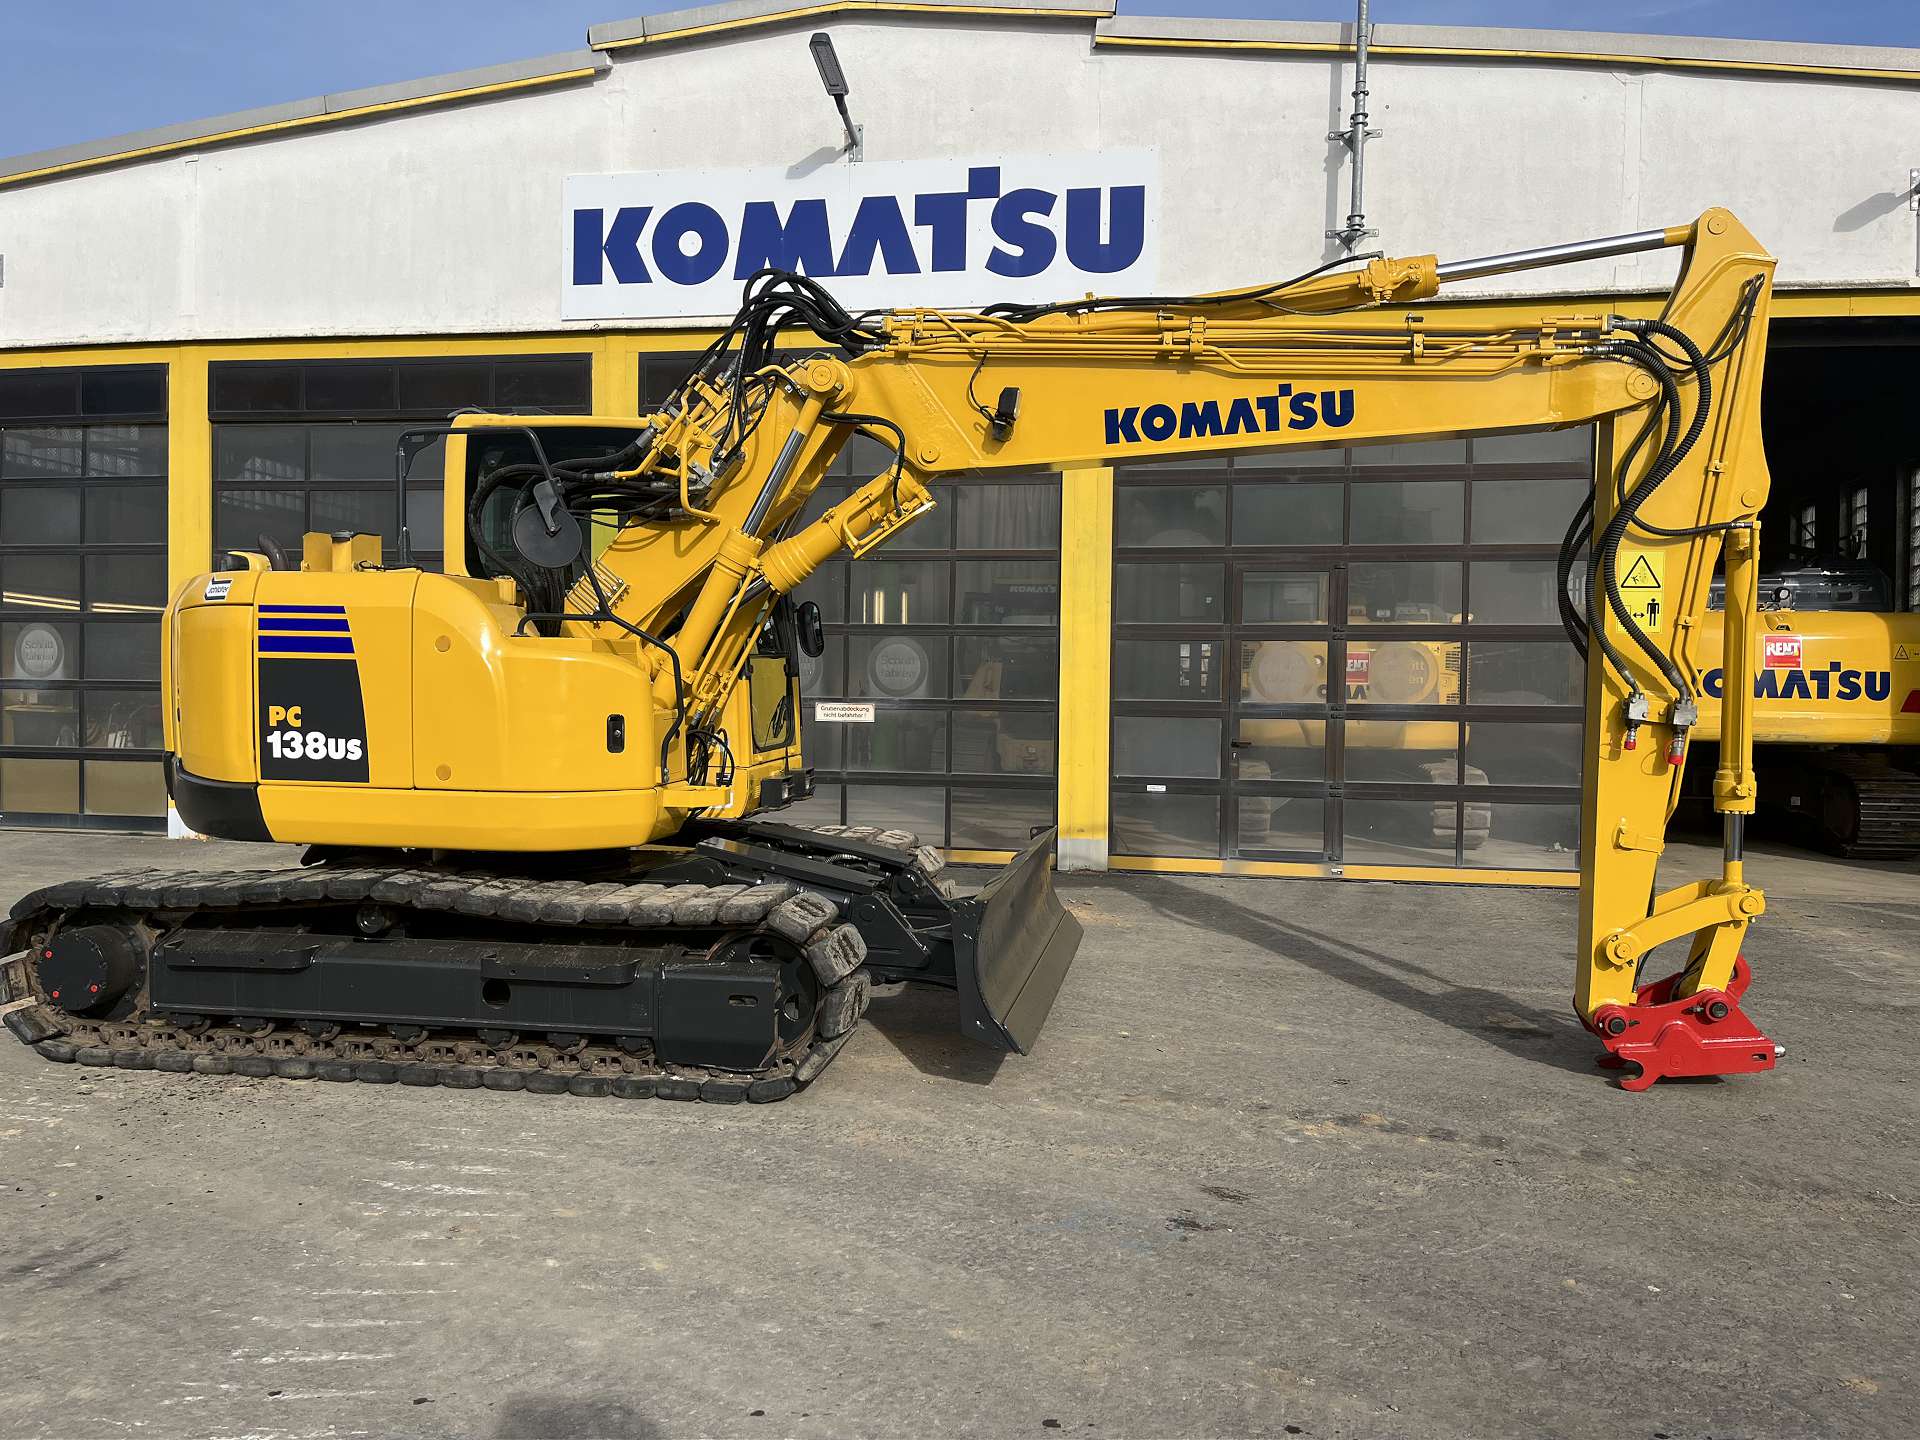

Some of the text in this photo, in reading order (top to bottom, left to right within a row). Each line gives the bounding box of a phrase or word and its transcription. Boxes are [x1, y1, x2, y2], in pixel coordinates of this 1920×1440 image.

[573, 166, 1145, 286] KOMATSU
[1104, 383, 1354, 445] KOMATSU
[1766, 641, 1799, 656] RENT
[268, 705, 302, 728] PC
